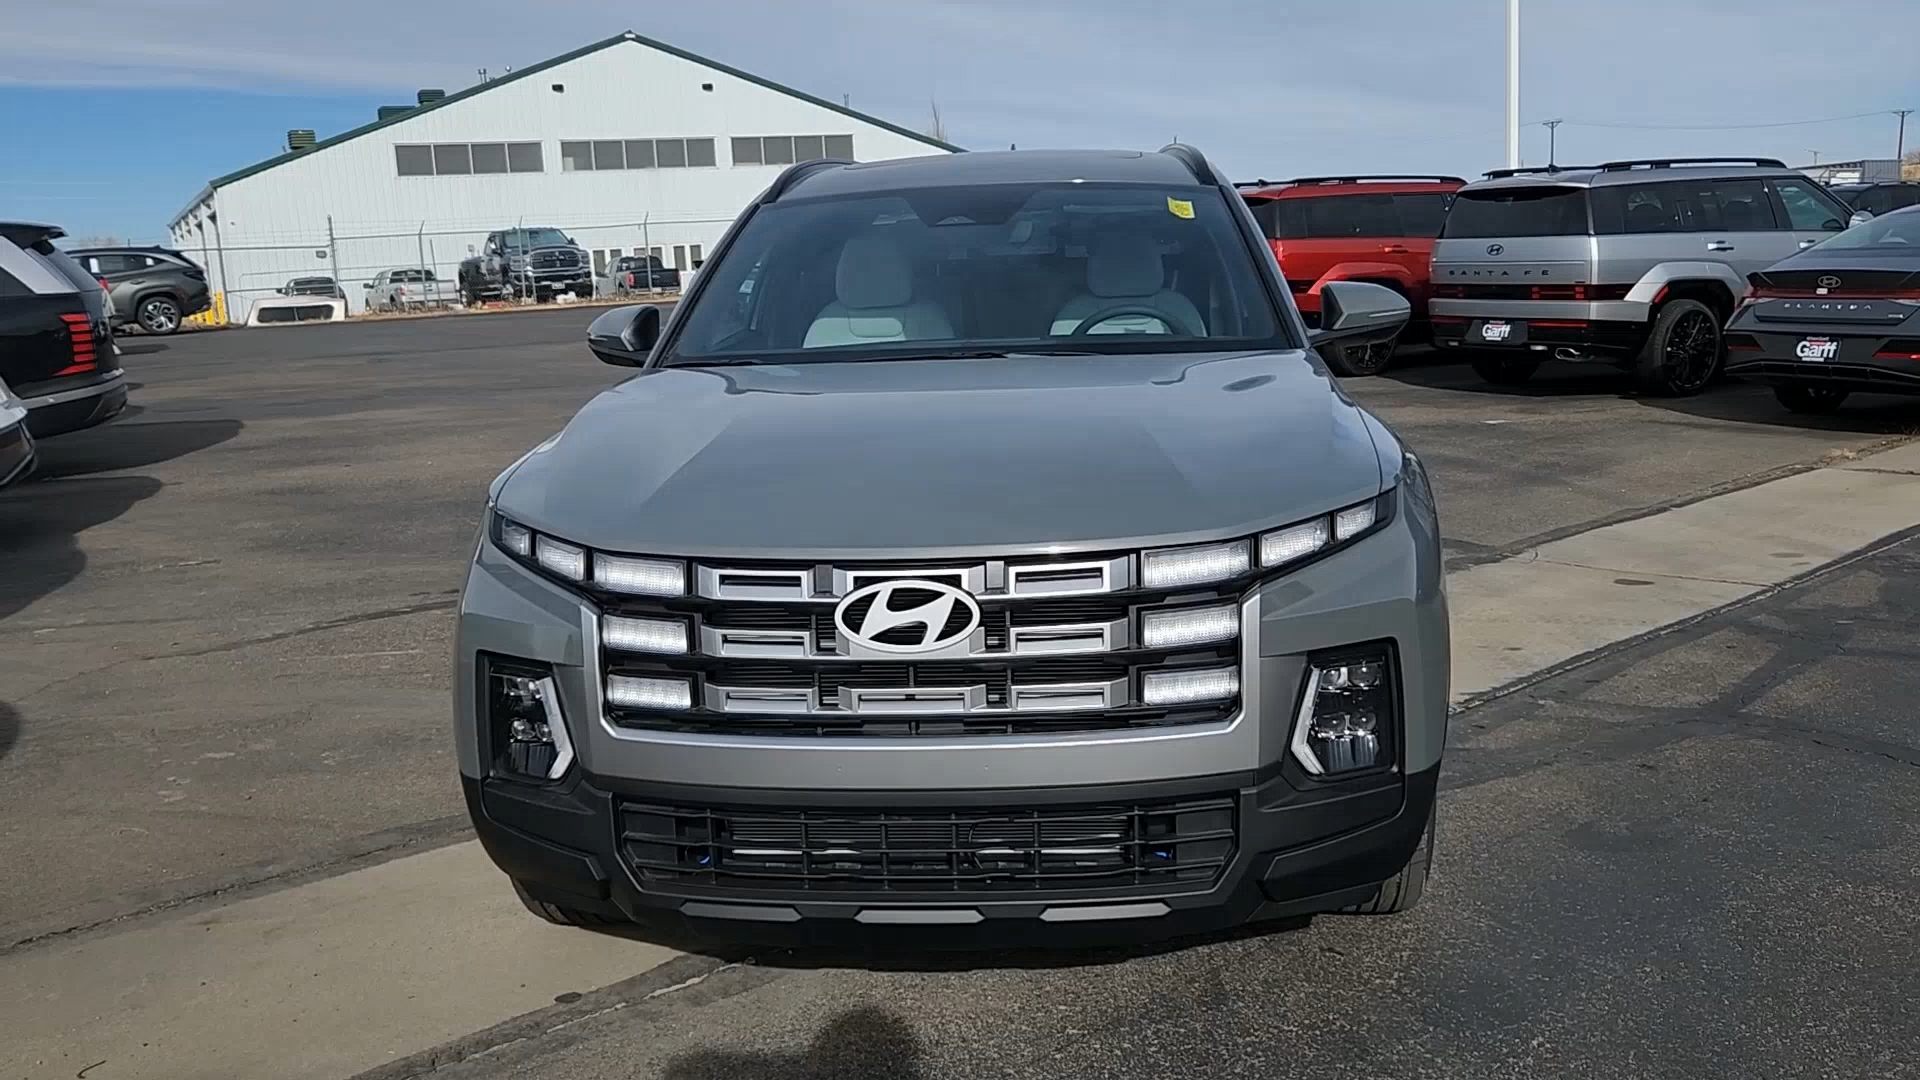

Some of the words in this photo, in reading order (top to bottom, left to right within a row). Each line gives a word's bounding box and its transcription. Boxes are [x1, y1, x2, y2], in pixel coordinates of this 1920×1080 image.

[1449, 269, 1510, 277] SANTA
[1482, 324, 1511, 338] Garff
[1796, 340, 1837, 358] Garff
